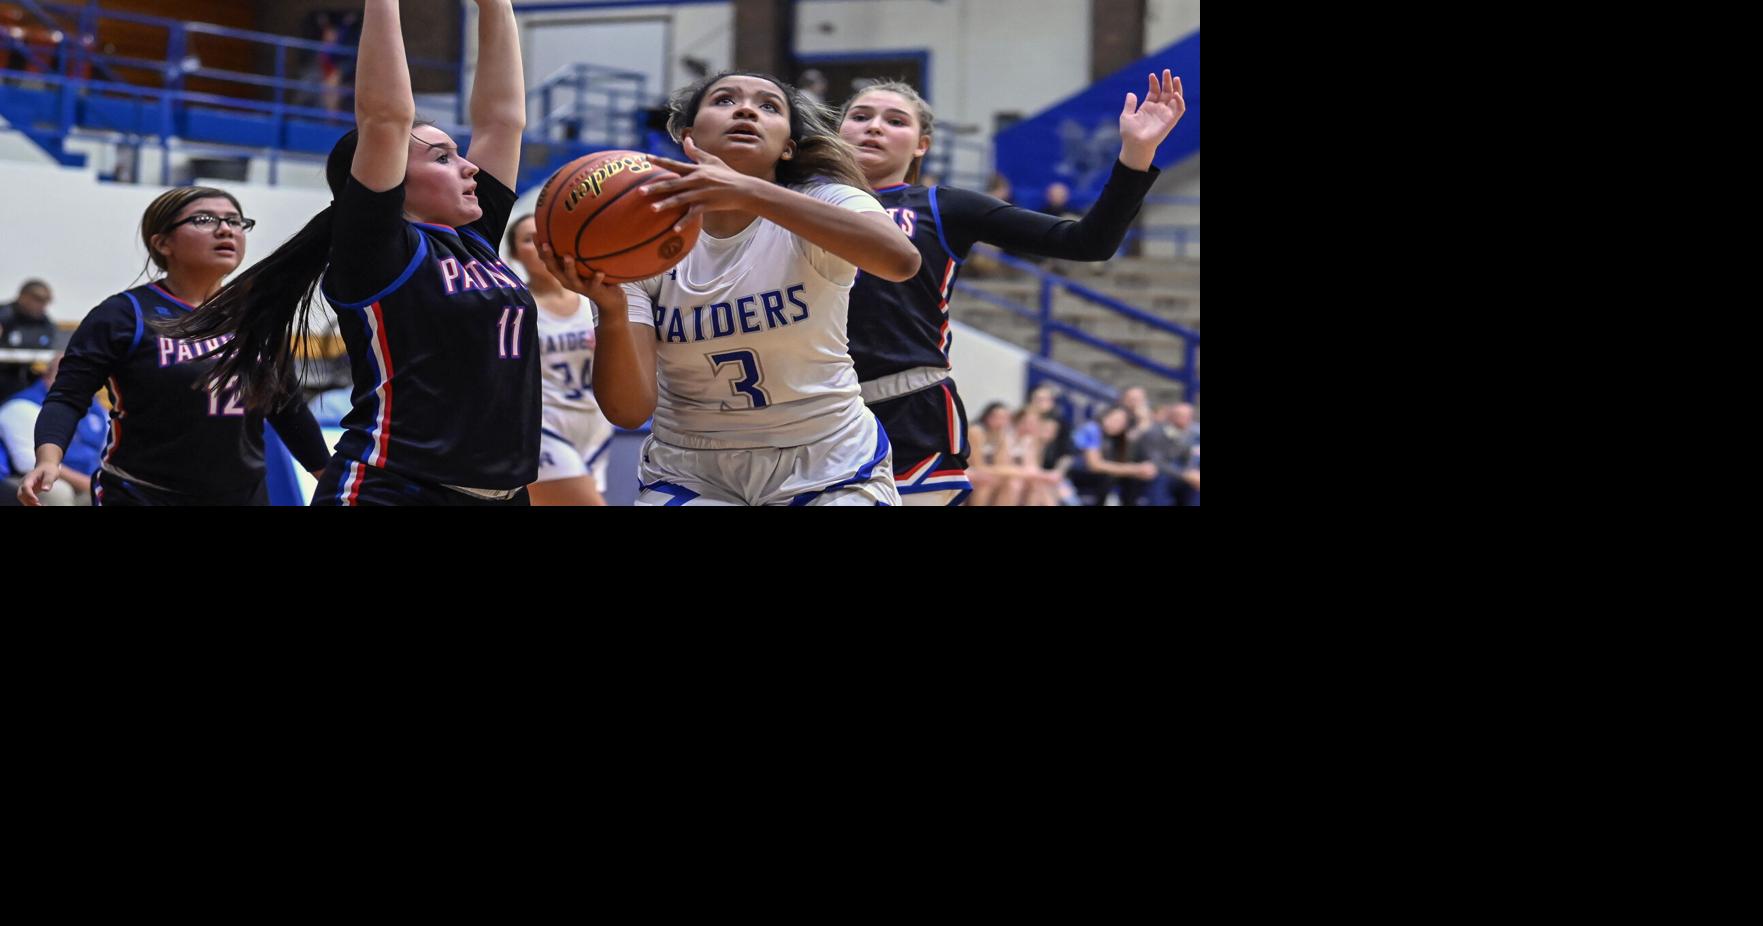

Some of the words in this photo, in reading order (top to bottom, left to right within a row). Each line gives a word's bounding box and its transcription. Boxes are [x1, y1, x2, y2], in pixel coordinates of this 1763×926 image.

[564, 154, 652, 212] Baden
[499, 307, 524, 359] 11
[653, 283, 810, 343] RAIDERS
[207, 374, 245, 416] 12
[704, 347, 772, 412] 3
